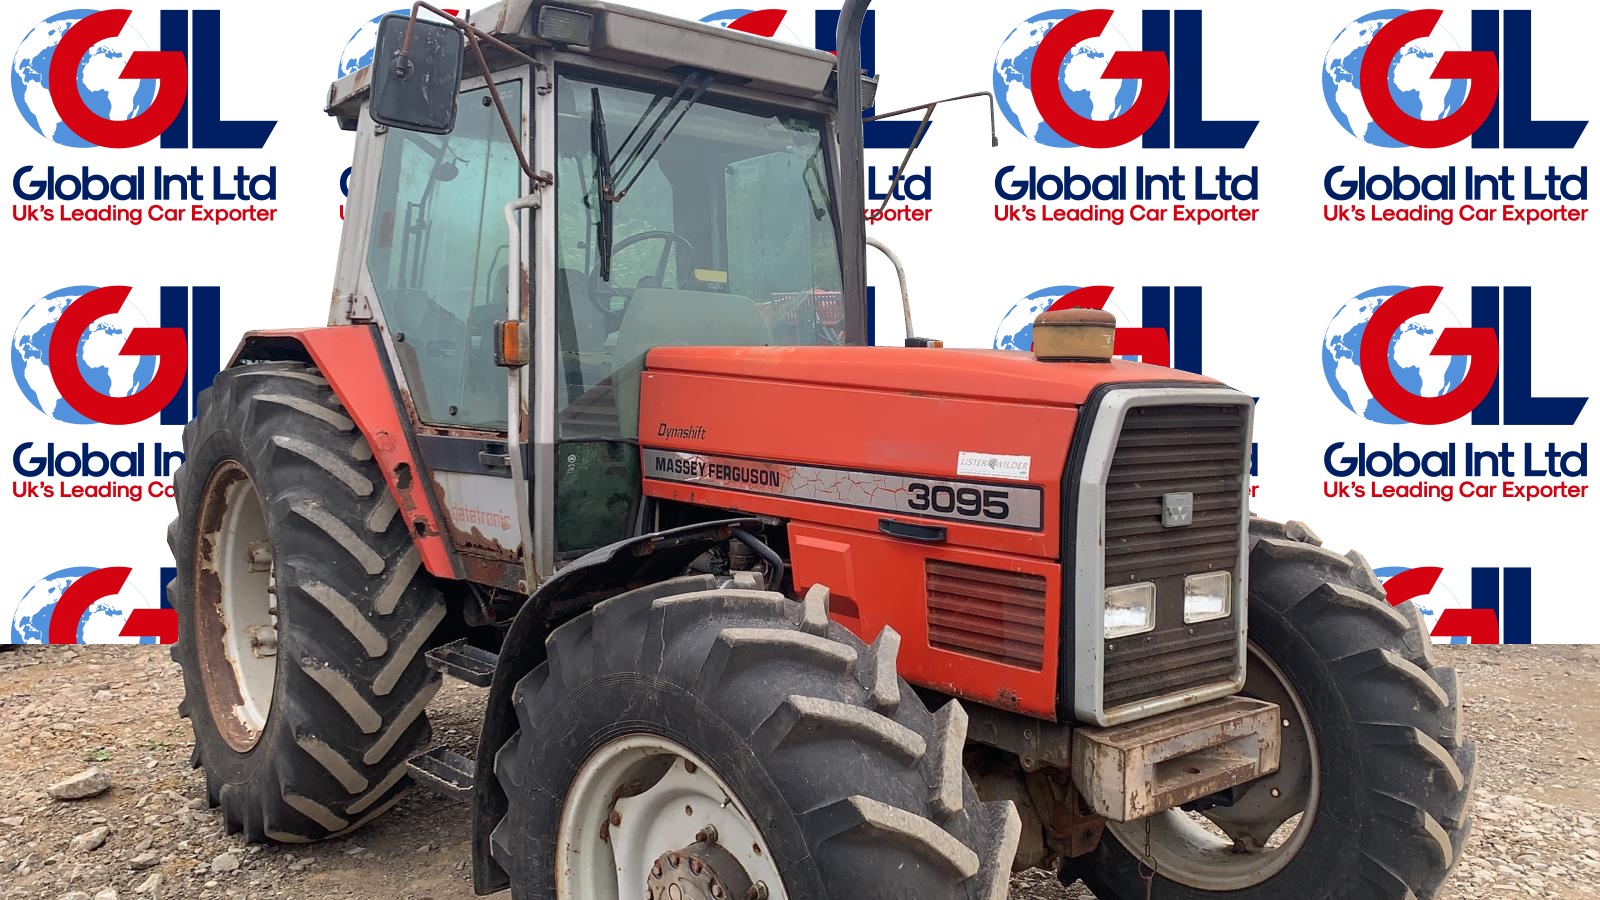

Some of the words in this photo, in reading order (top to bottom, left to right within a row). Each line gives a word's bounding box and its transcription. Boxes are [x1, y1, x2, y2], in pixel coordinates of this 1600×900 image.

[657, 422, 707, 441] Dynashift
[655, 456, 706, 477] MASSEY
[708, 463, 780, 488] FERGUSON
[960, 457, 988, 468] LISTER
[907, 482, 1010, 520] 3095
